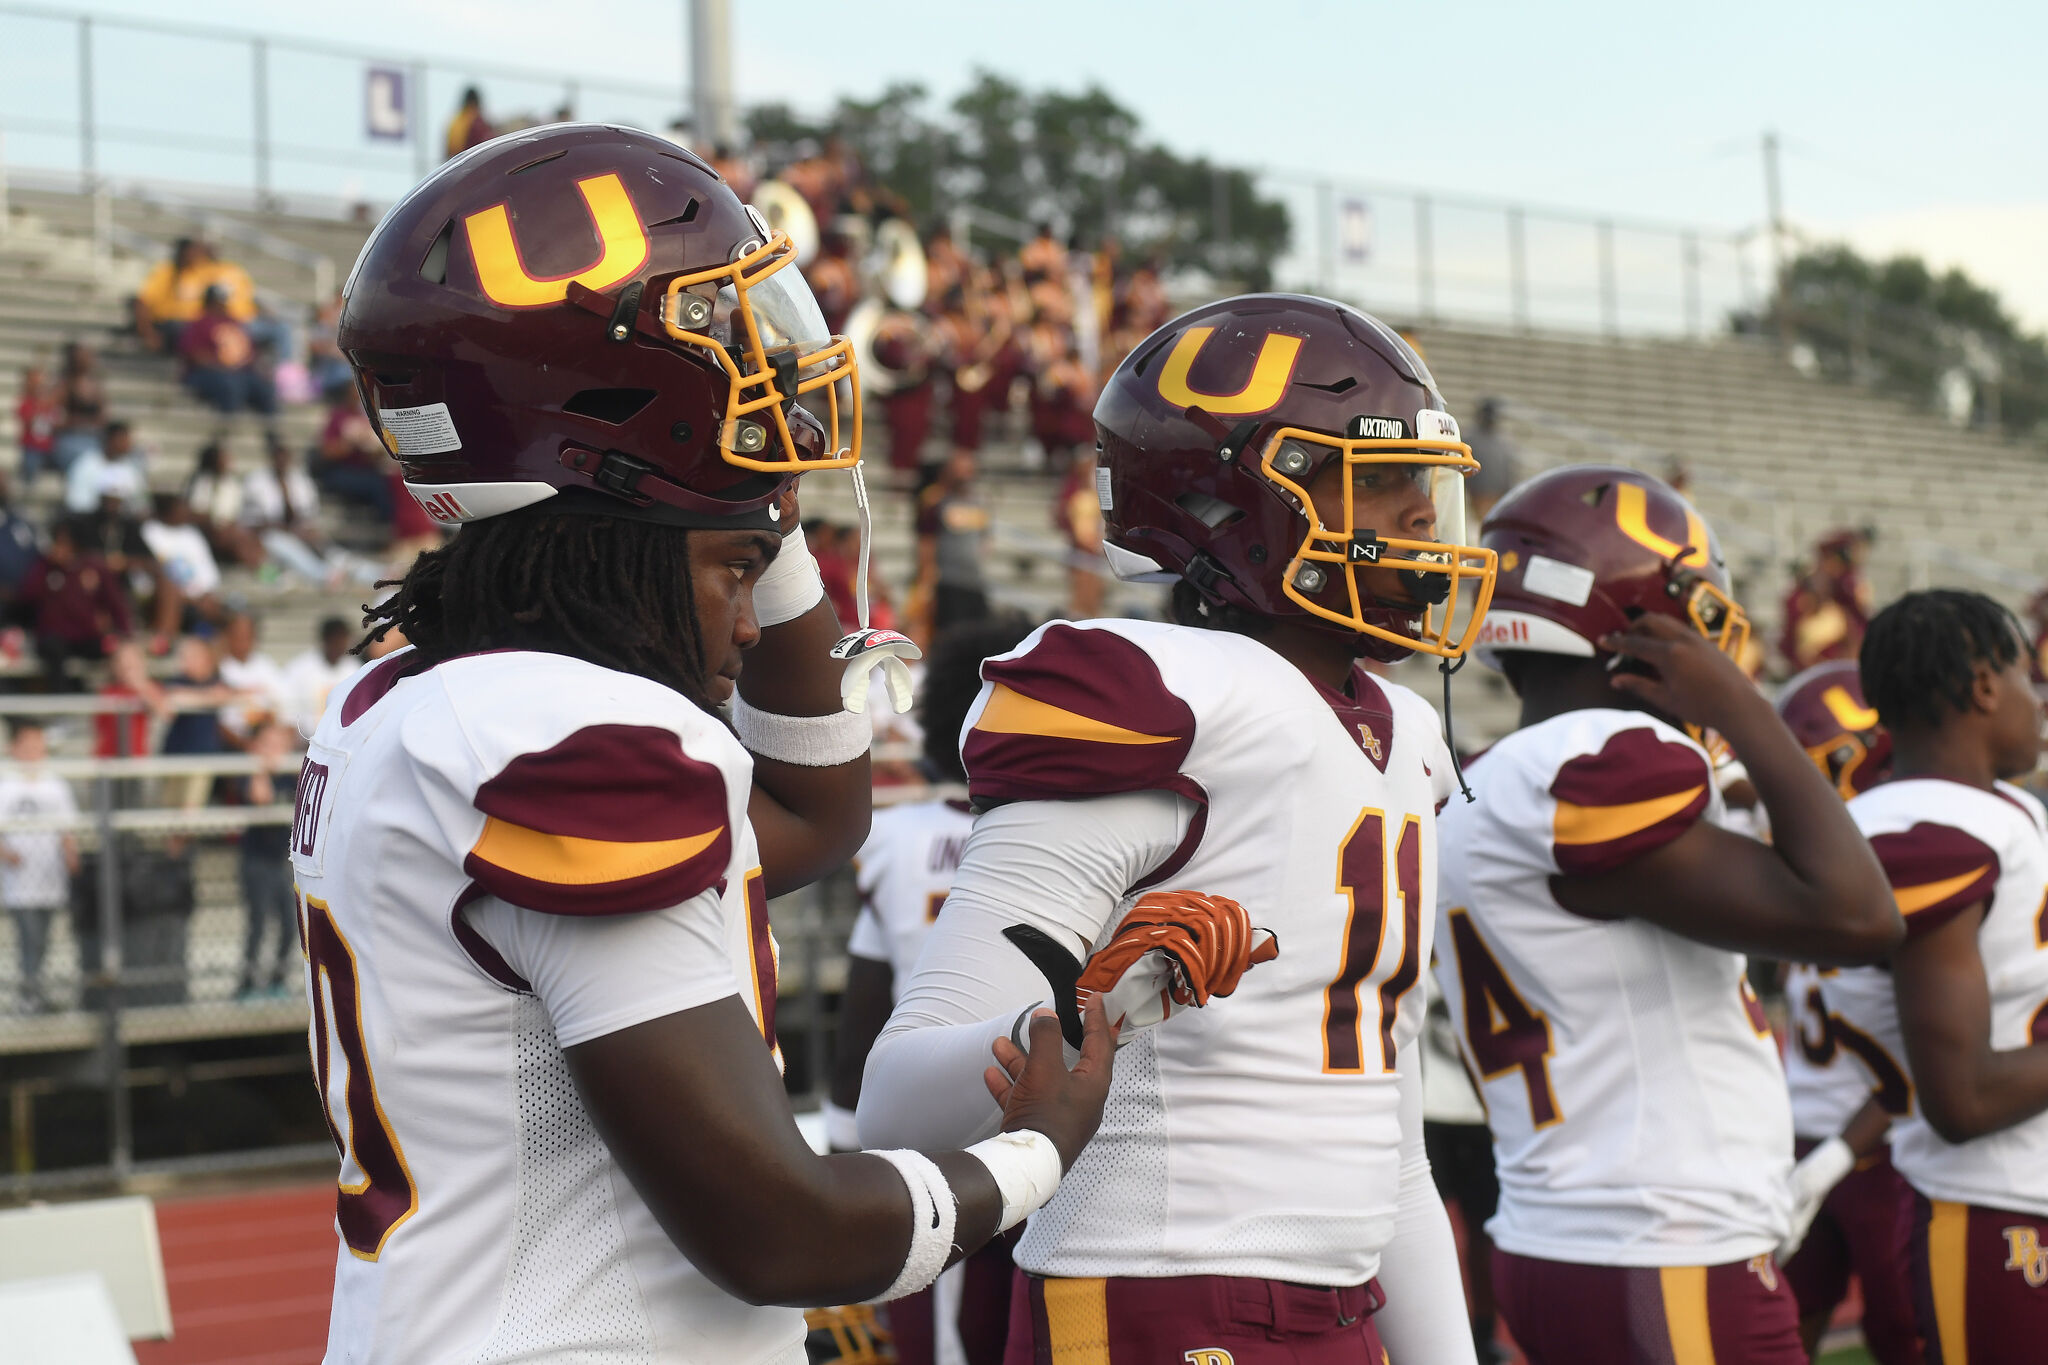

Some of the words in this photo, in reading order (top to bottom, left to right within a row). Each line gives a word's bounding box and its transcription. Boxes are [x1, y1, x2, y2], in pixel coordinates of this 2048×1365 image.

[463, 169, 651, 310] U
[394, 408, 421, 418] WARNING
[1157, 325, 1307, 417] U
[1359, 417, 1403, 439] NXTRND
[1616, 481, 1710, 570] U
[1321, 806, 1422, 1076] 11
